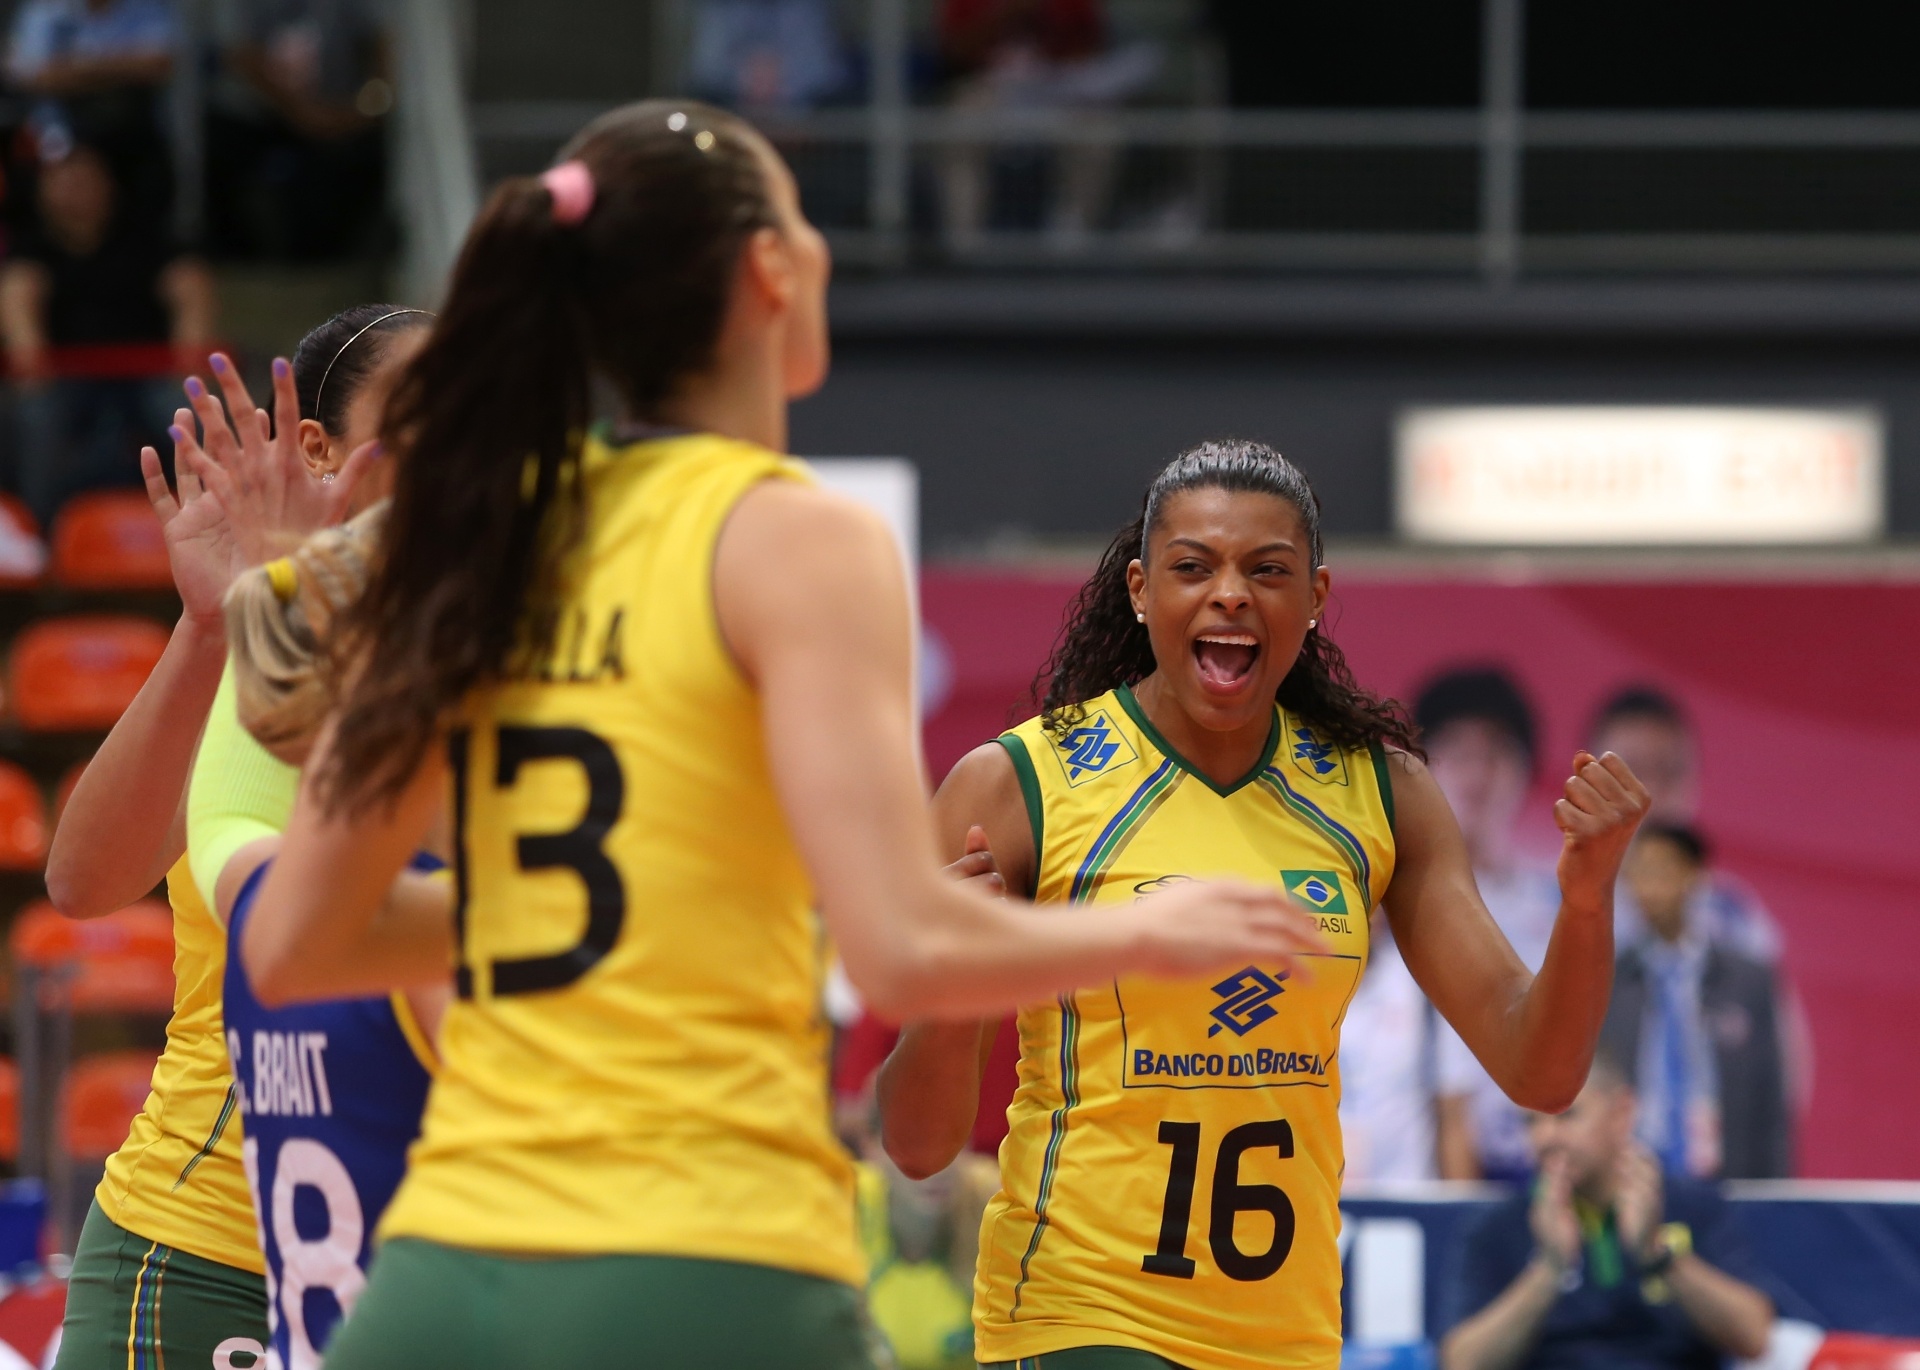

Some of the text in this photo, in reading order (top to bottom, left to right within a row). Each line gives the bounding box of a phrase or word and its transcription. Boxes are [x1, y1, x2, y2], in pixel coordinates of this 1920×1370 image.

[446, 724, 629, 1003] 13
[1305, 916, 1353, 935] RASIL
[252, 1030, 333, 1116] BRAIT
[1134, 1048, 1326, 1077] BANCO DO BRASIL
[1140, 1118, 1296, 1282] 16
